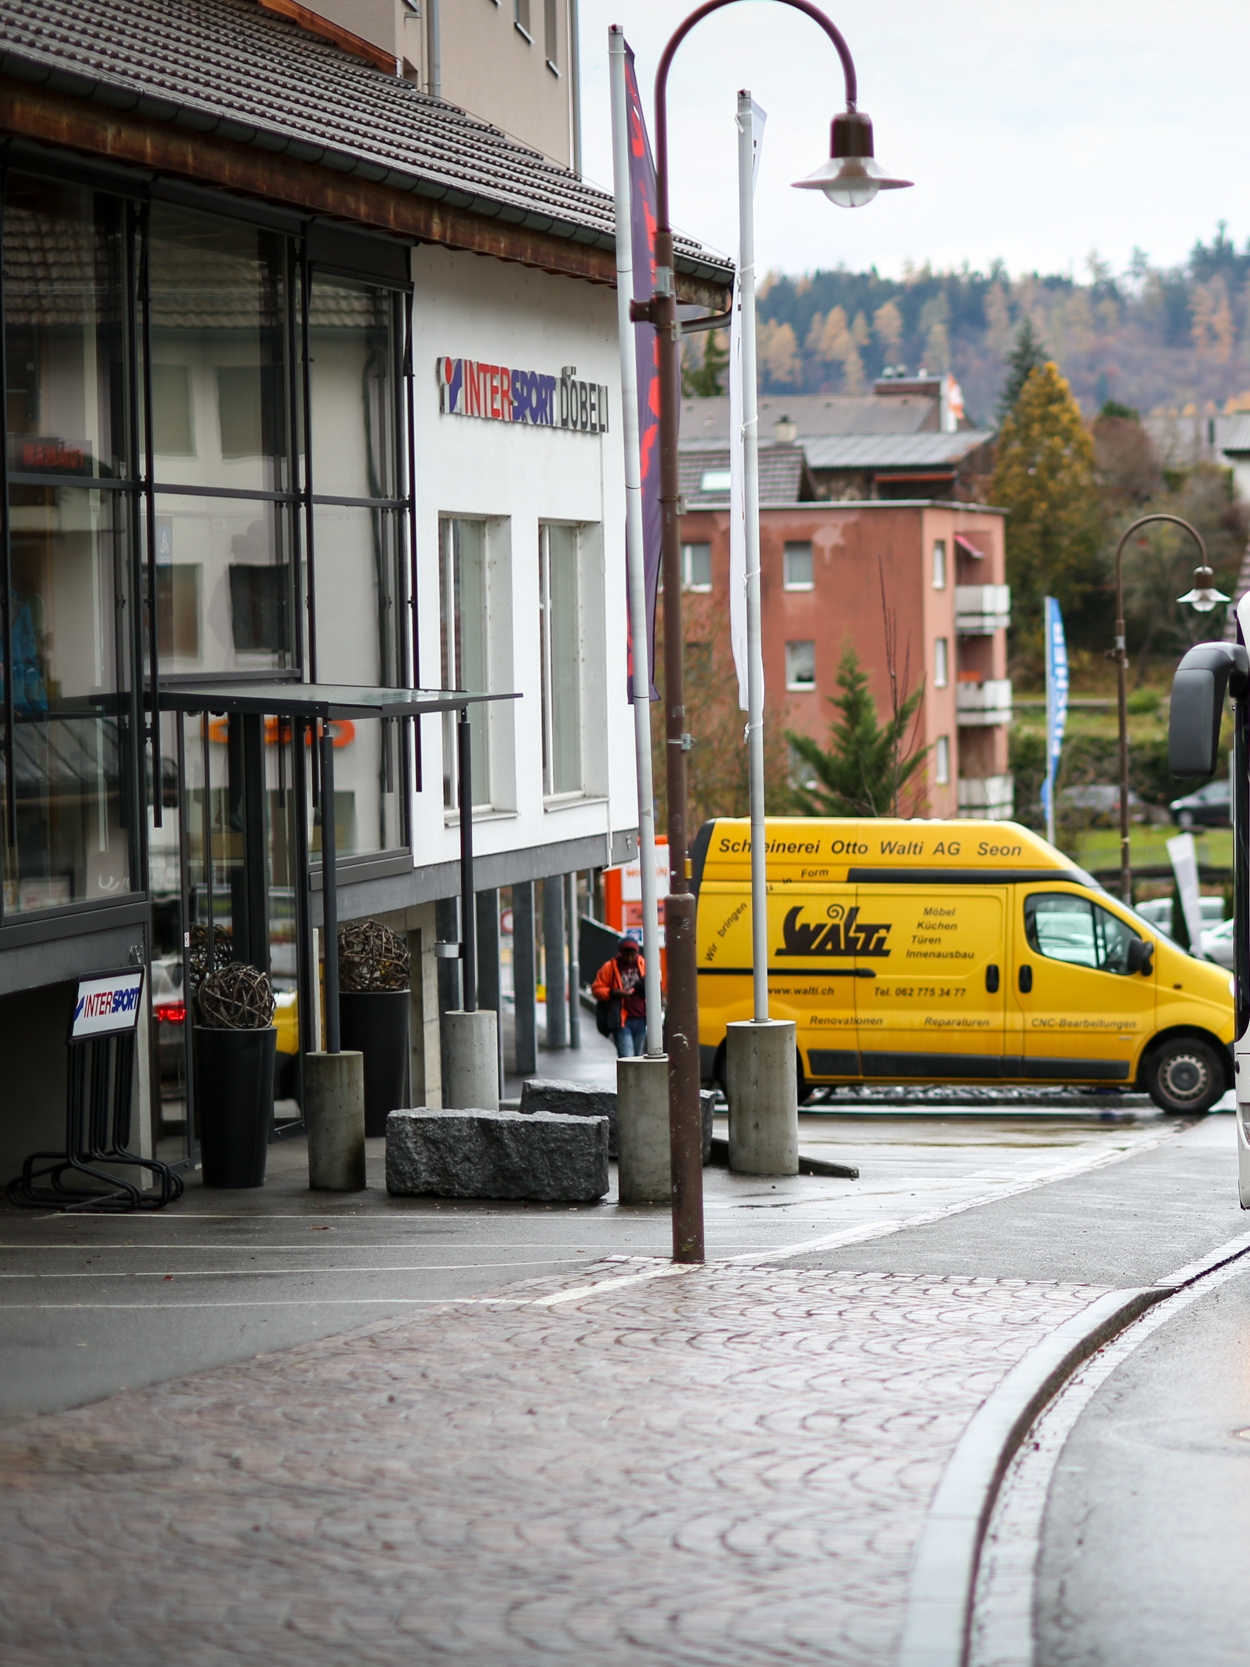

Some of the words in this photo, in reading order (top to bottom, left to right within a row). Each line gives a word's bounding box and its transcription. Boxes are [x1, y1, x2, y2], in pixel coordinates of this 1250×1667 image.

[464, 359, 556, 425] INTERSPORT
[560, 366, 609, 433] DÖBELI
[719, 838, 820, 853] Scheinerei
[831, 840, 868, 854] Otto
[880, 841, 924, 855] Walti
[933, 842, 961, 856] AG
[977, 842, 1022, 856] Seon
[801, 869, 829, 878] Form
[923, 907, 956, 917] Möbel
[916, 921, 957, 931] Küchen
[704, 942, 718, 962] Wir
[717, 902, 747, 938] bringen
[911, 934, 941, 945] Türen
[906, 949, 975, 960] Innenausbau
[767, 986, 834, 996] www.walti.ch
[874, 986, 890, 997] Tel.
[895, 986, 913, 997] 062
[917, 986, 935, 997] 775
[938, 986, 950, 998] 34
[954, 987, 966, 998] 77
[84, 986, 140, 1019] INTERSPORT
[809, 1015, 883, 1026] Renovationen
[924, 1016, 990, 1029] Reparaturen
[1031, 1017, 1137, 1030] CNC-Bearbeitungen
